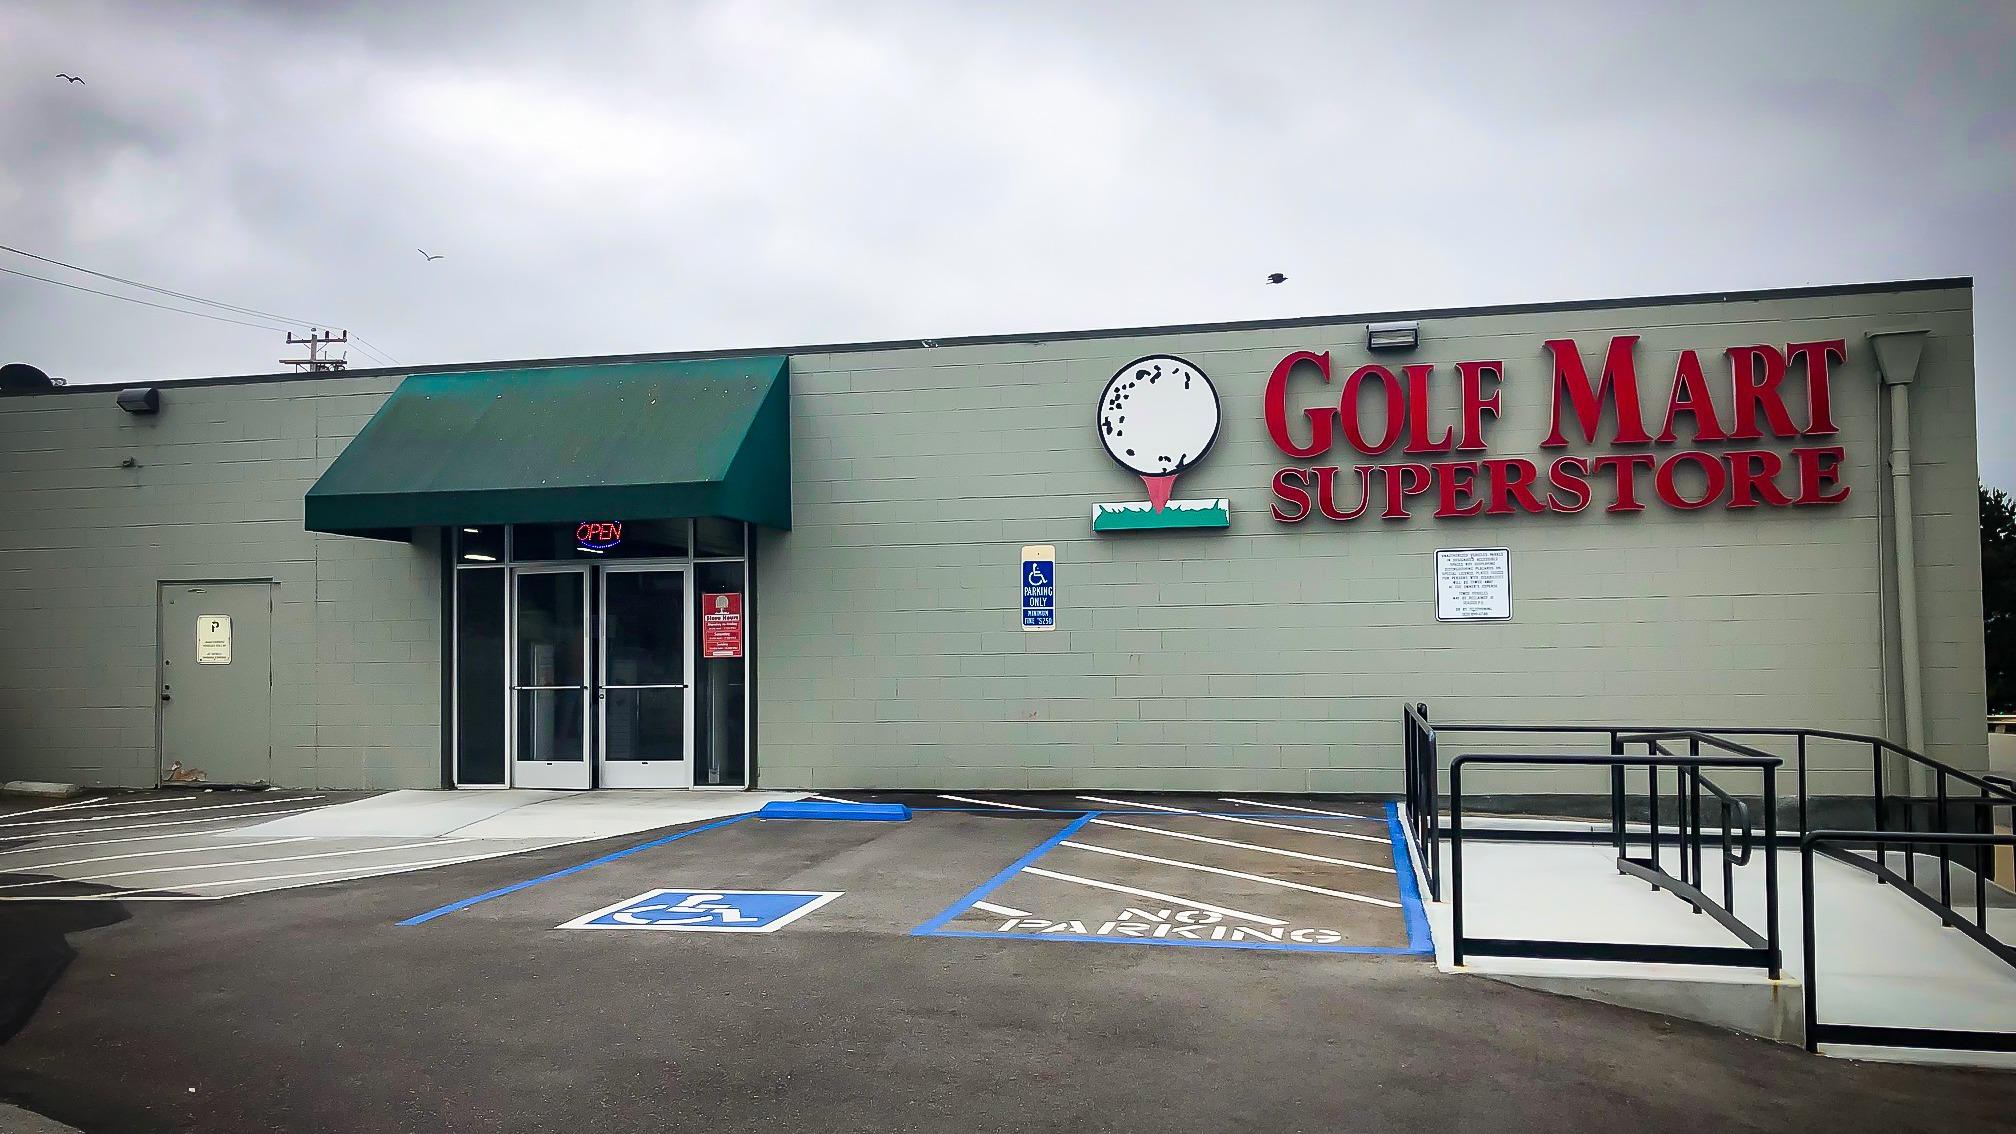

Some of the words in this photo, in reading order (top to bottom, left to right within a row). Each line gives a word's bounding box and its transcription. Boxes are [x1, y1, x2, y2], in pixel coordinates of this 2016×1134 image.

[1263, 350, 1504, 458] GOLF
[1539, 335, 1847, 448] MART
[1270, 446, 1851, 523] SUPERSTORE
[577, 523, 622, 541] OPEN
[1024, 586, 1053, 596] PARKING
[1030, 597, 1047, 606] ONLY
[1116, 908, 1223, 925] NO
[998, 918, 1342, 944] PARKING
